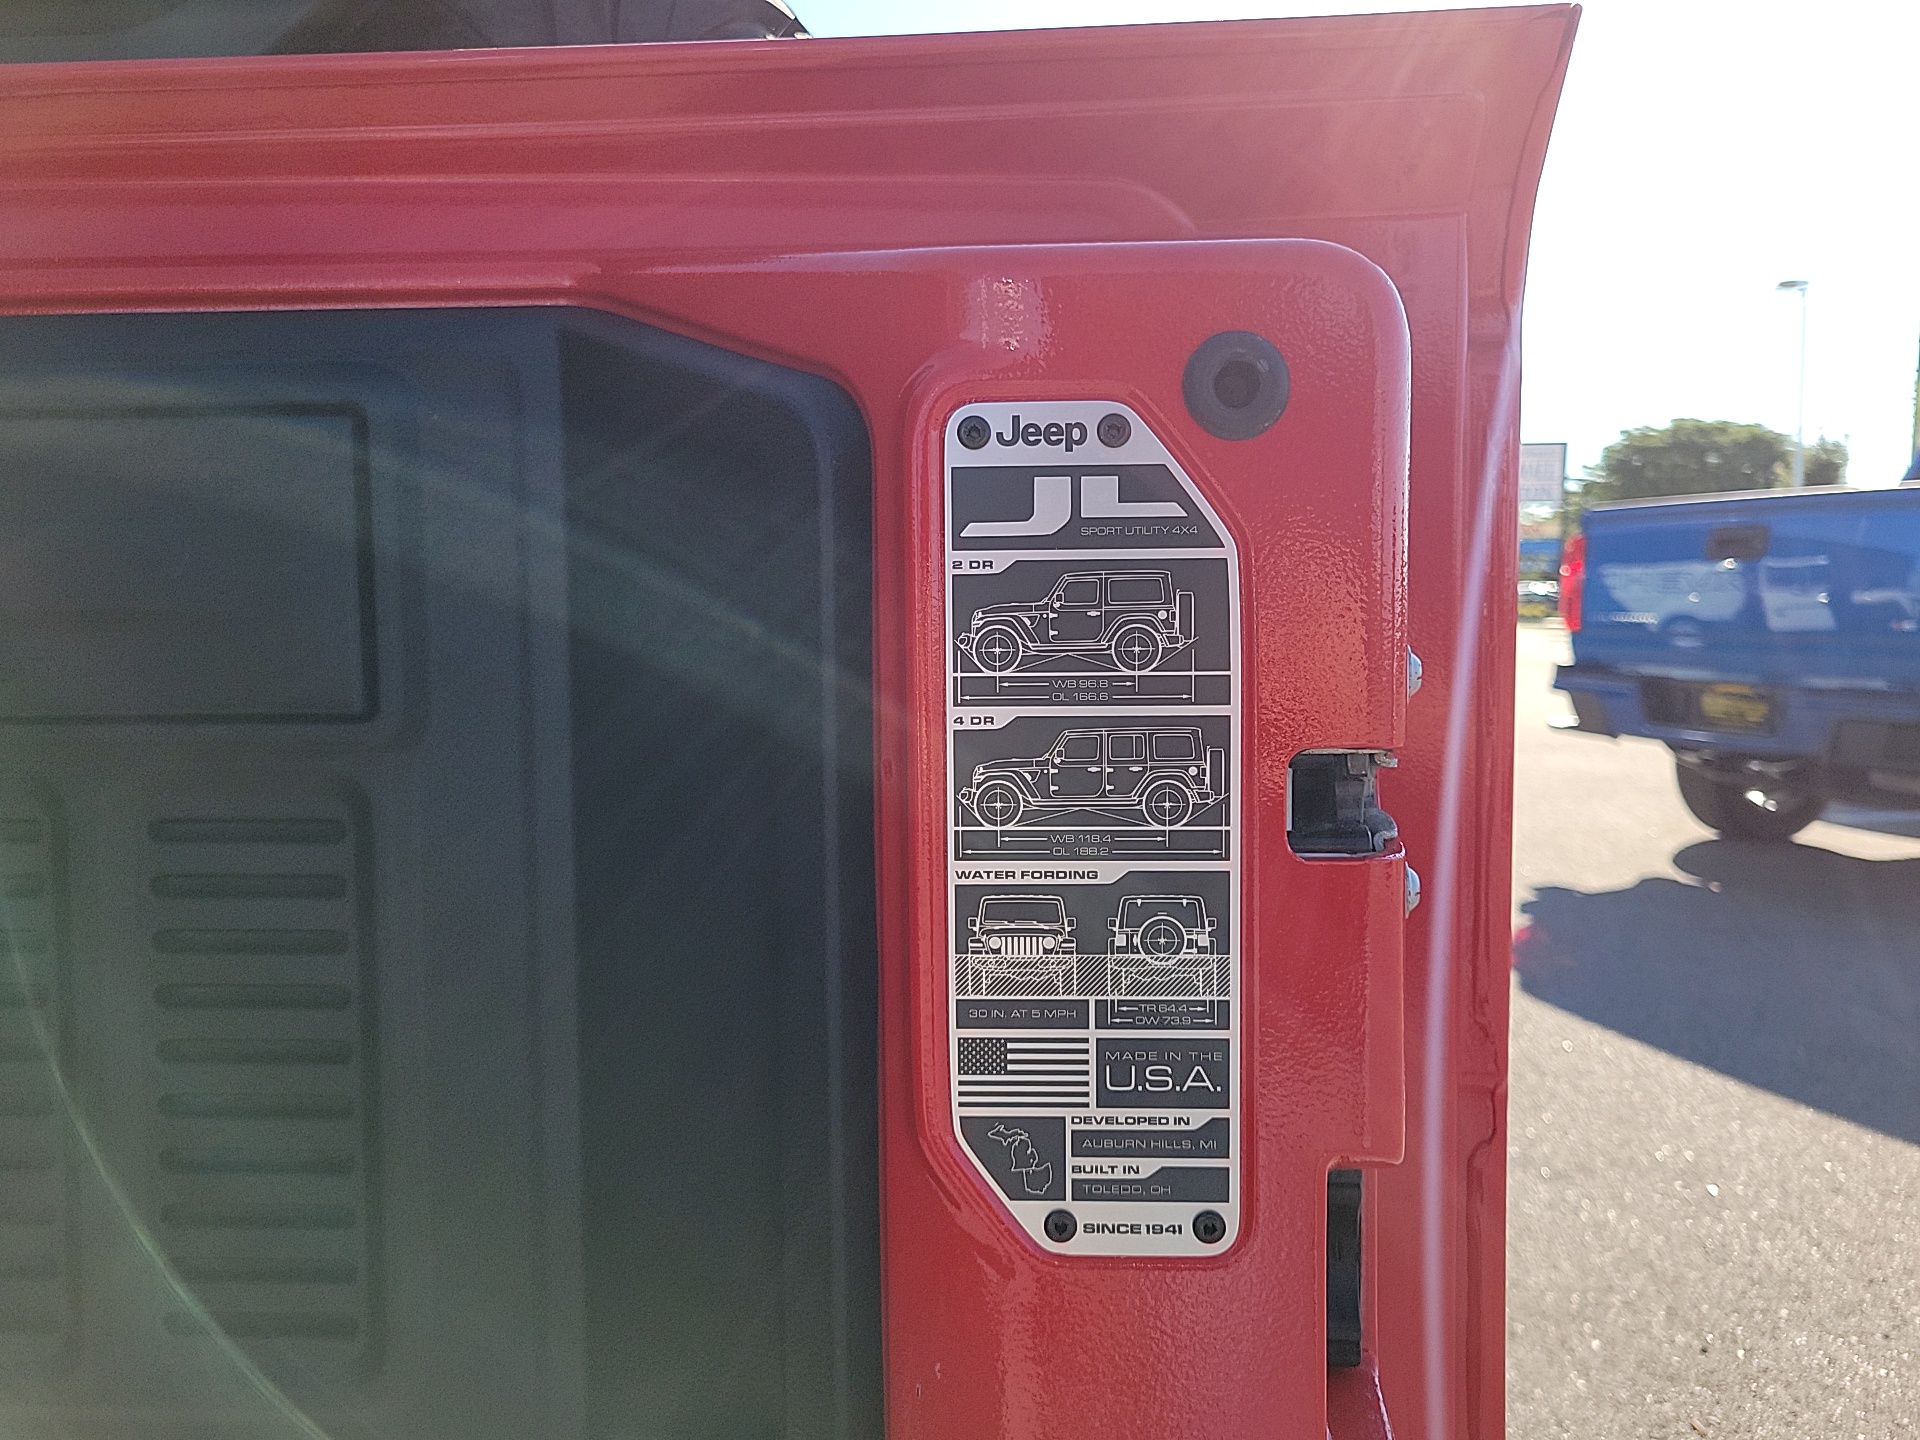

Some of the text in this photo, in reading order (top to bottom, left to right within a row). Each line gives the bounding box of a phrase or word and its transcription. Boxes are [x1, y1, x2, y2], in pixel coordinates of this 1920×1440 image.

[996, 415, 1088, 452] Jeep
[960, 475, 1188, 537] JL
[1080, 525, 1198, 536] SPORT UTILITY 4X4
[951, 560, 994, 570] 2 DR
[1051, 679, 1109, 688] WB 96.8
[1052, 692, 1070, 701] OL
[953, 716, 995, 726] 4 DR
[1050, 834, 1111, 843] WB 118.4
[1052, 847, 1109, 856] OL 188.2
[955, 870, 1099, 880] WATER FORDING
[1138, 1003, 1188, 1014] TR 64.4
[968, 1009, 1077, 1019] 30 IN. AT 5 MPH
[1135, 1016, 1191, 1025] OW 73.9
[1105, 1051, 1223, 1061] MADE IN THE
[1105, 1065, 1222, 1092] U.S.A.
[1071, 1116, 1190, 1126] DEVELOPED IN
[1082, 1139, 1217, 1151] AUBURN HILLS, MI
[1071, 1165, 1140, 1175] BUILT IN
[1082, 1184, 1172, 1195] TOLEDO, OH
[1083, 1223, 1183, 1235] SINCE 1941
